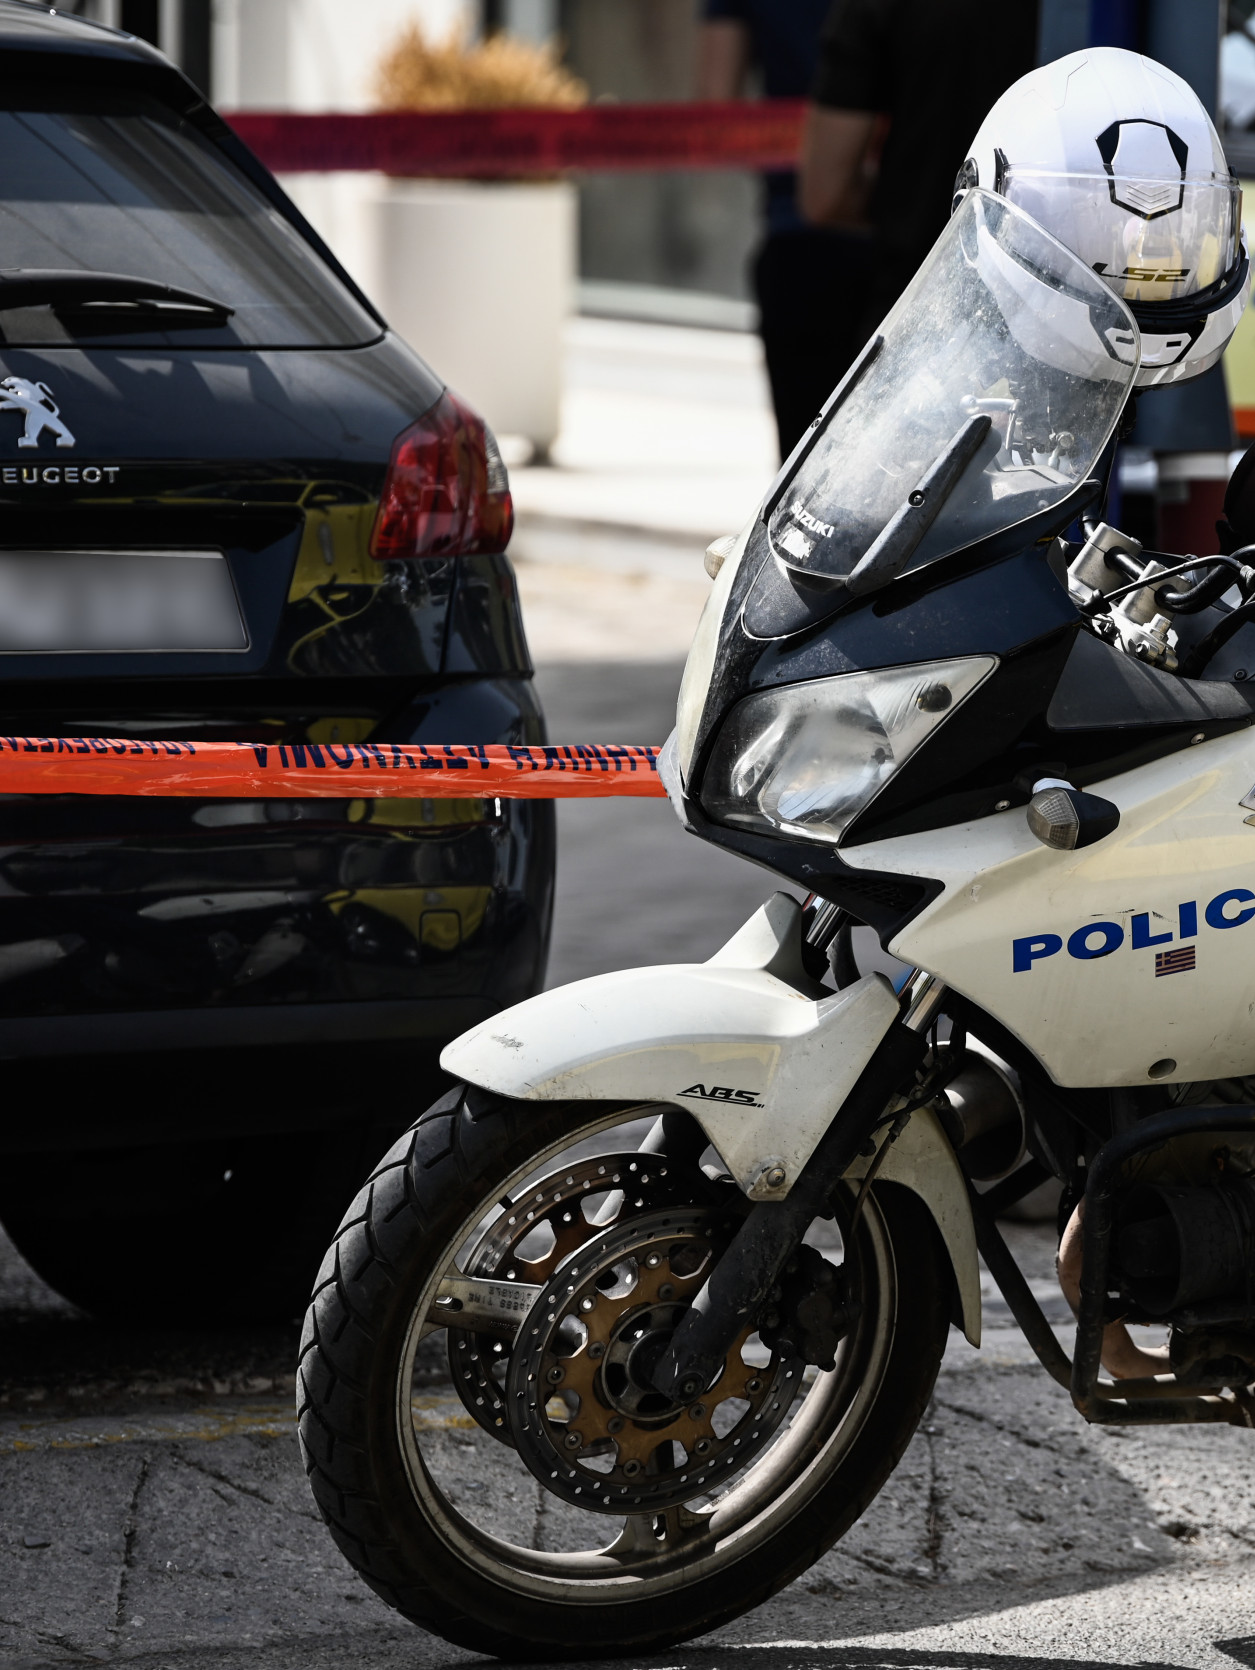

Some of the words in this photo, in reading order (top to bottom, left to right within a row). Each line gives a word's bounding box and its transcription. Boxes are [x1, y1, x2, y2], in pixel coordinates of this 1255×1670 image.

[1092, 262, 1191, 282] LS2
[2, 466, 120, 484] EUGEOT
[790, 500, 835, 538] SUZUKI
[681, 1083, 761, 1103] ABS
